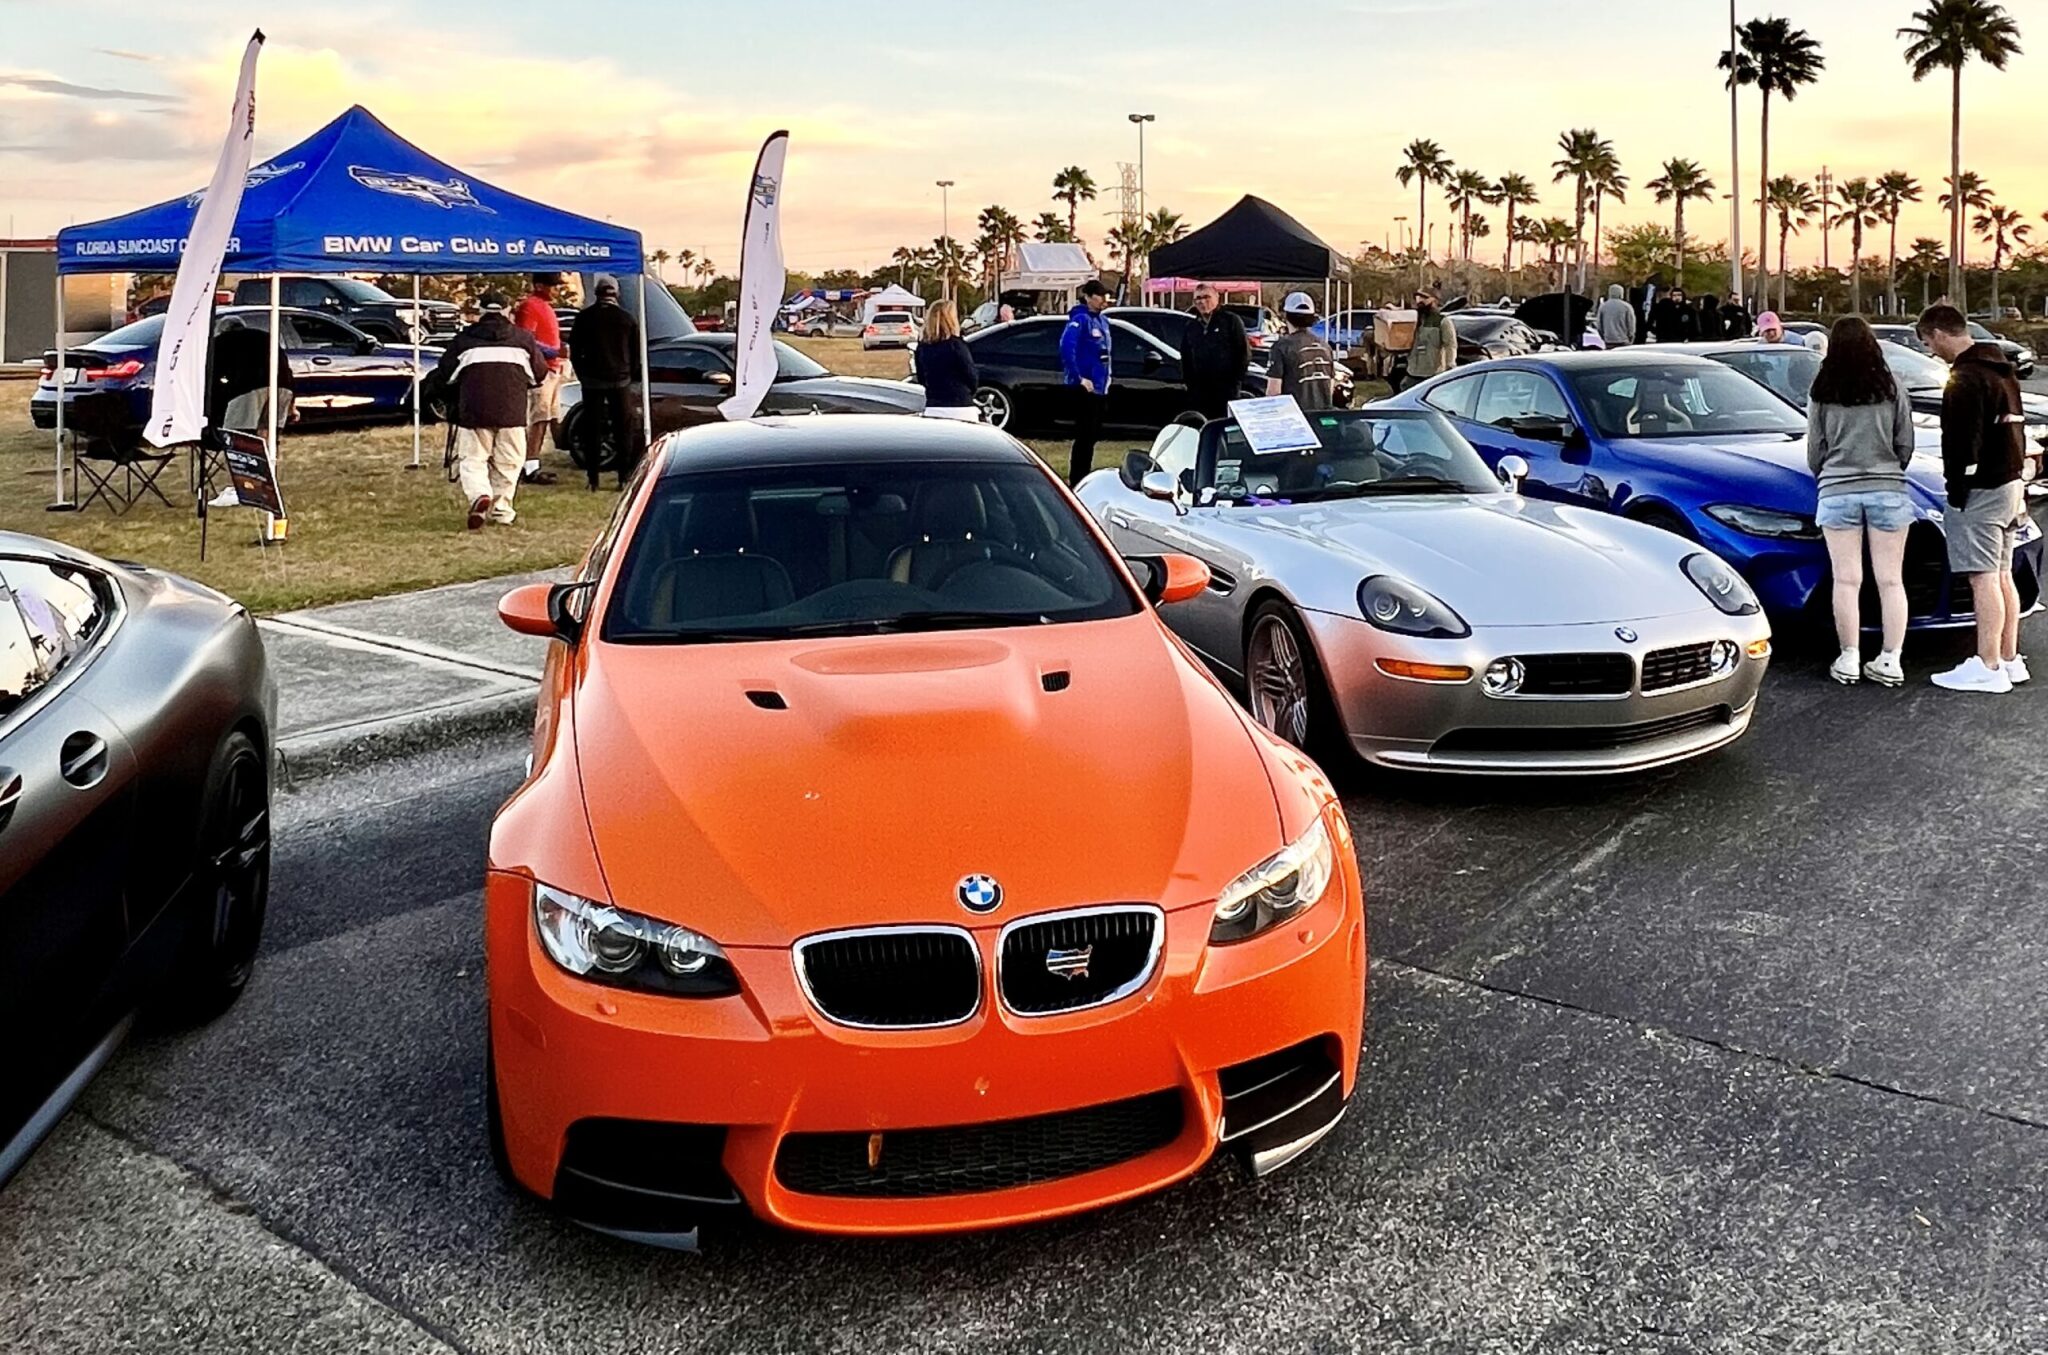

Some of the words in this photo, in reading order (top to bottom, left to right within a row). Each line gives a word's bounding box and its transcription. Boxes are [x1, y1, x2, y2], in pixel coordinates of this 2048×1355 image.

[76, 241, 116, 255] FLORIDA
[117, 239, 177, 254] SUNCOAST
[324, 236, 393, 253] BMW
[400, 236, 444, 252] Car
[450, 237, 499, 254] Club
[506, 239, 526, 254] of
[532, 240, 610, 257] America
